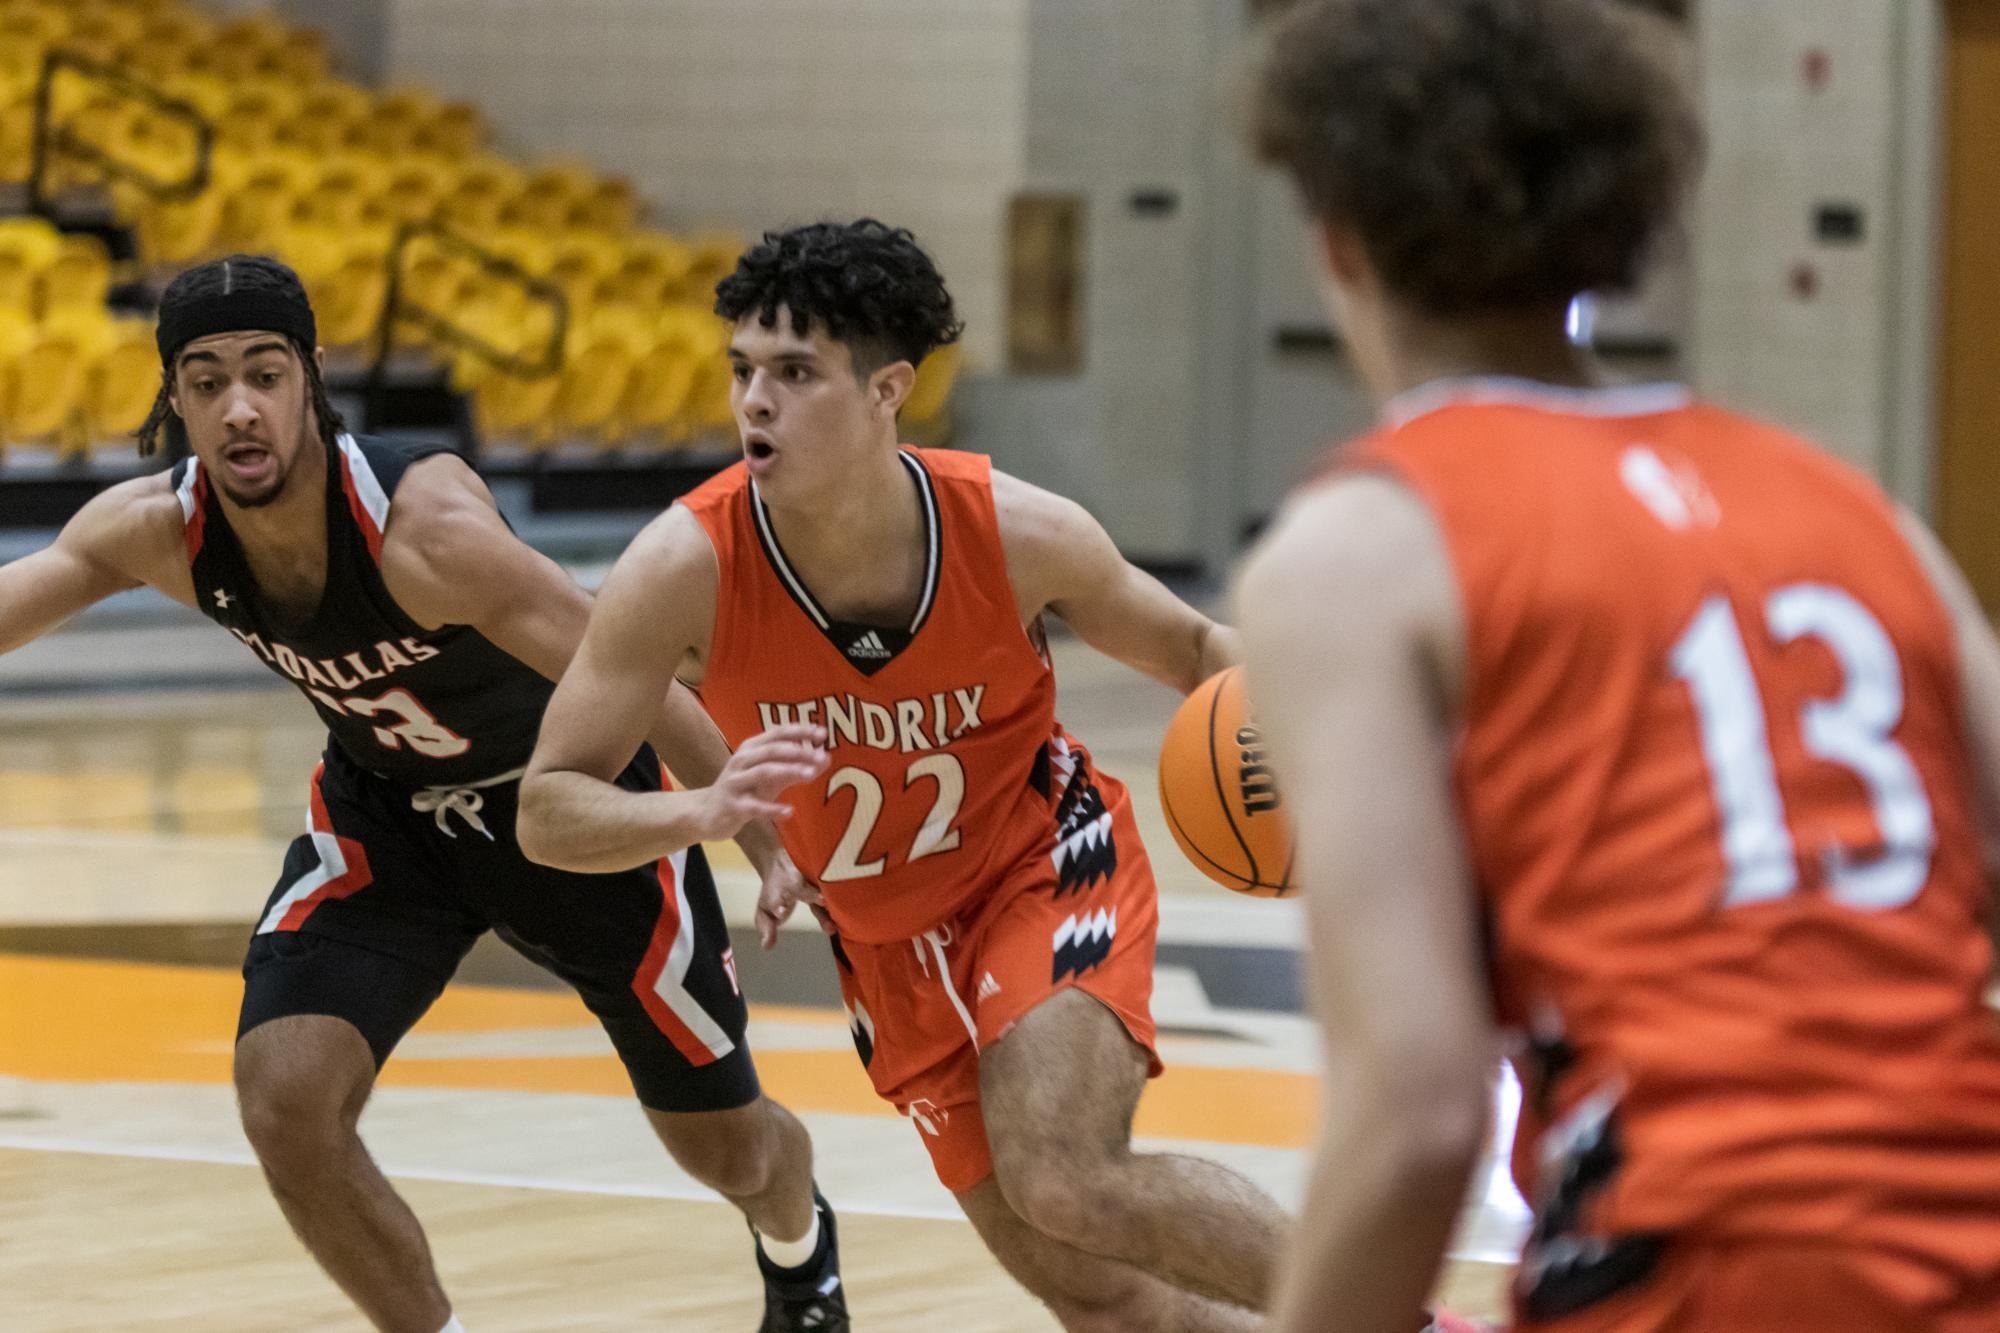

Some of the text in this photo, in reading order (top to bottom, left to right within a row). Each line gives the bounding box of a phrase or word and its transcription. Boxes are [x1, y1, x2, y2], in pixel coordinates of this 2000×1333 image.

[271, 637, 440, 690] DALLAS
[848, 647, 891, 658] adidas
[1668, 582, 1937, 910] 13
[818, 753, 965, 882] 22
